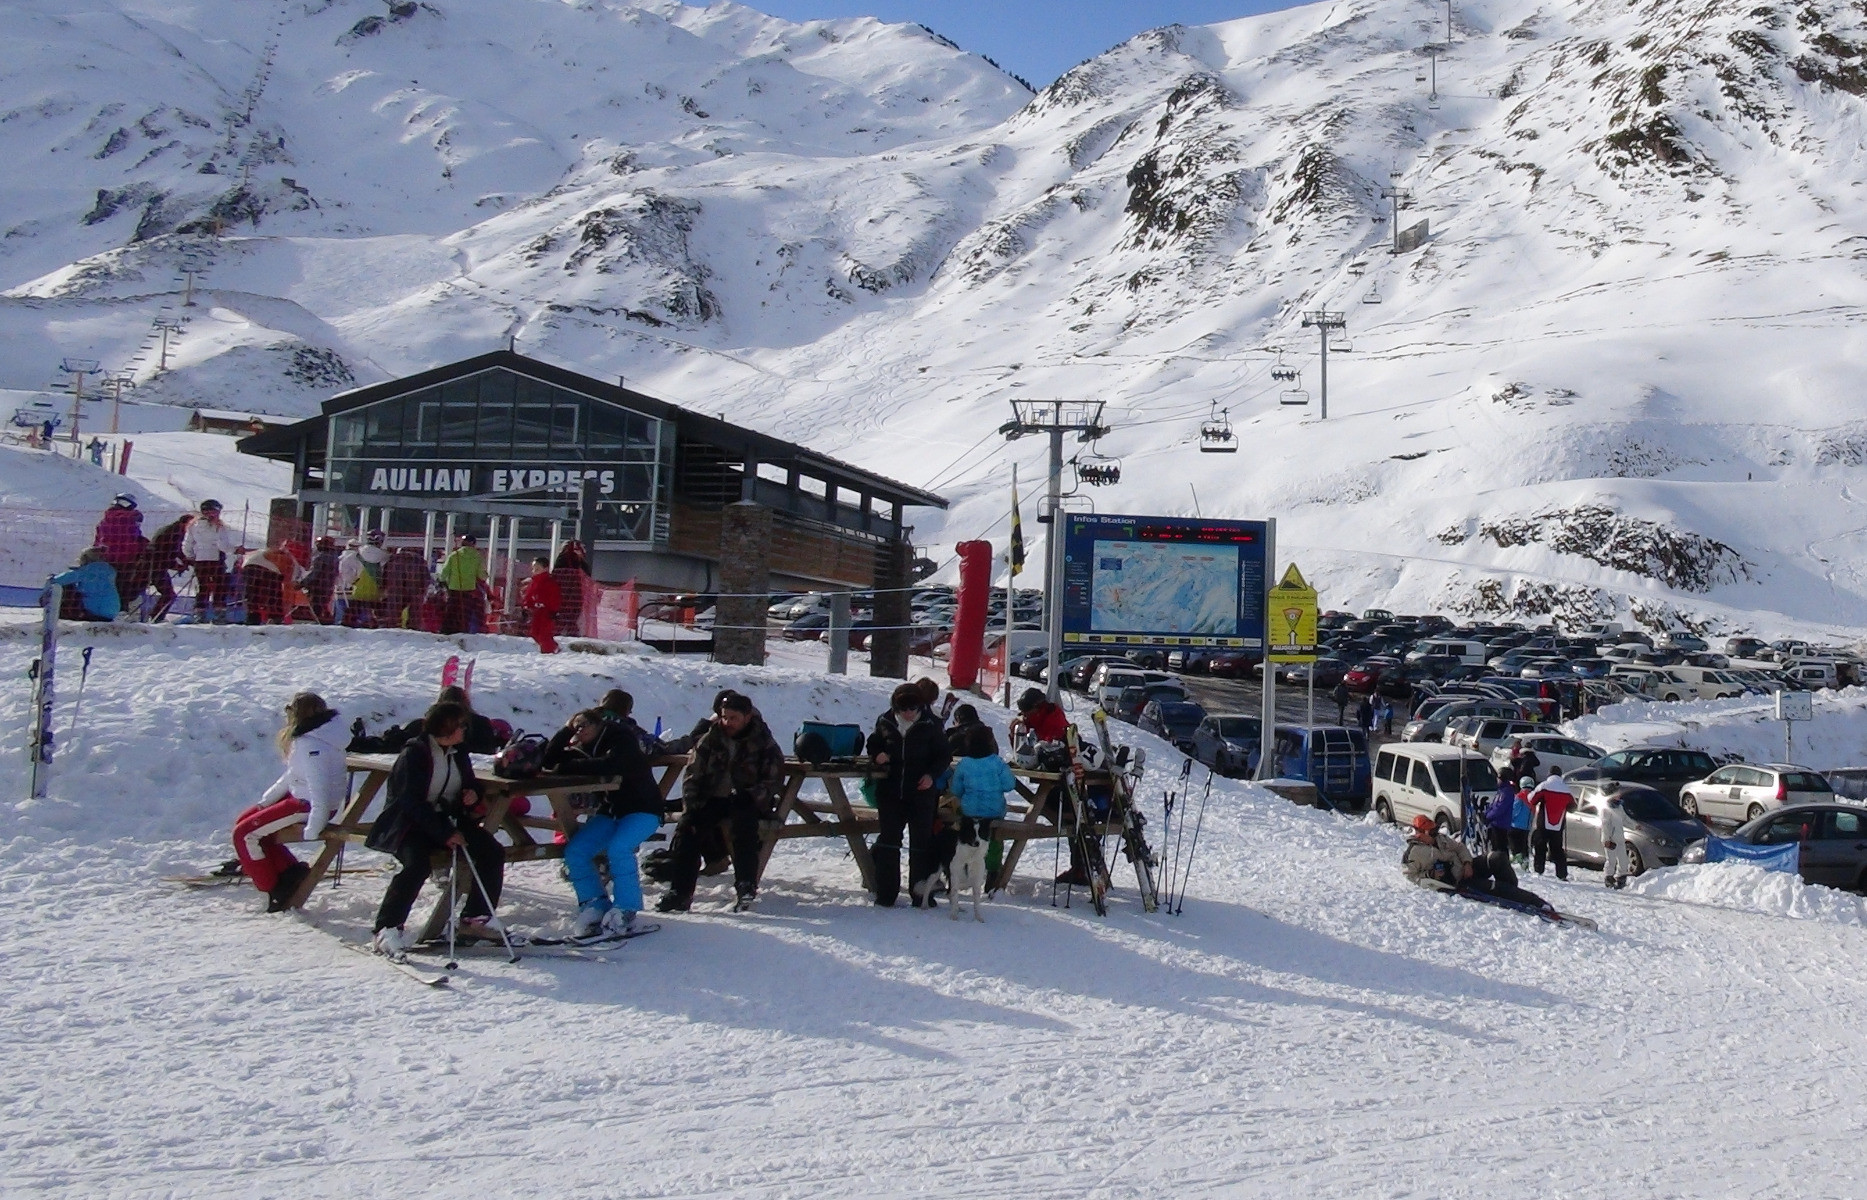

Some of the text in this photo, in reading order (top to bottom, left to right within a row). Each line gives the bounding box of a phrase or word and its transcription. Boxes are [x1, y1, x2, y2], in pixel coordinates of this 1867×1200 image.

[370, 467, 471, 492] AULIAN
[1073, 515, 1136, 525] Infos Station
